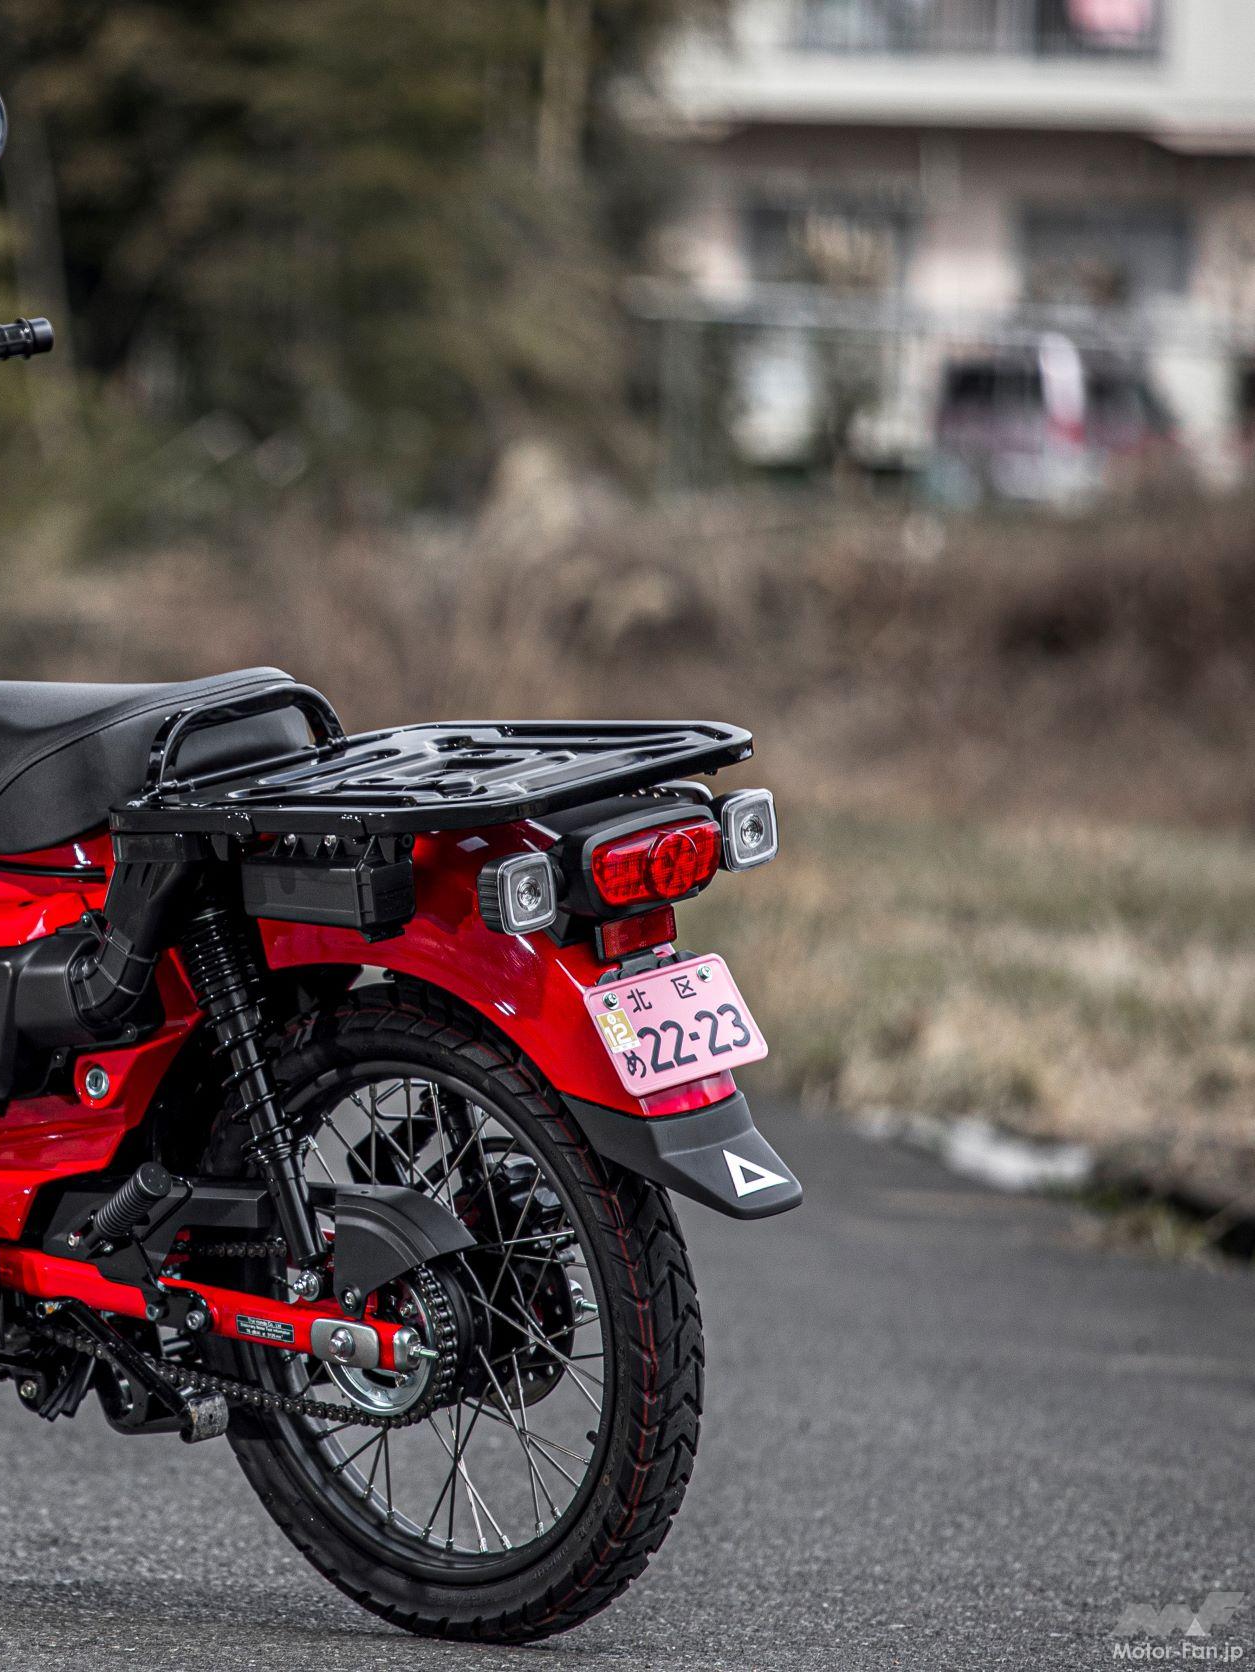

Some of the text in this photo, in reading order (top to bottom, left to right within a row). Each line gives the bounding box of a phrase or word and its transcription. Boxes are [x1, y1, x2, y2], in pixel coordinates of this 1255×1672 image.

[604, 1022, 632, 1048] 12
[622, 1003, 751, 1079] め 22-23
